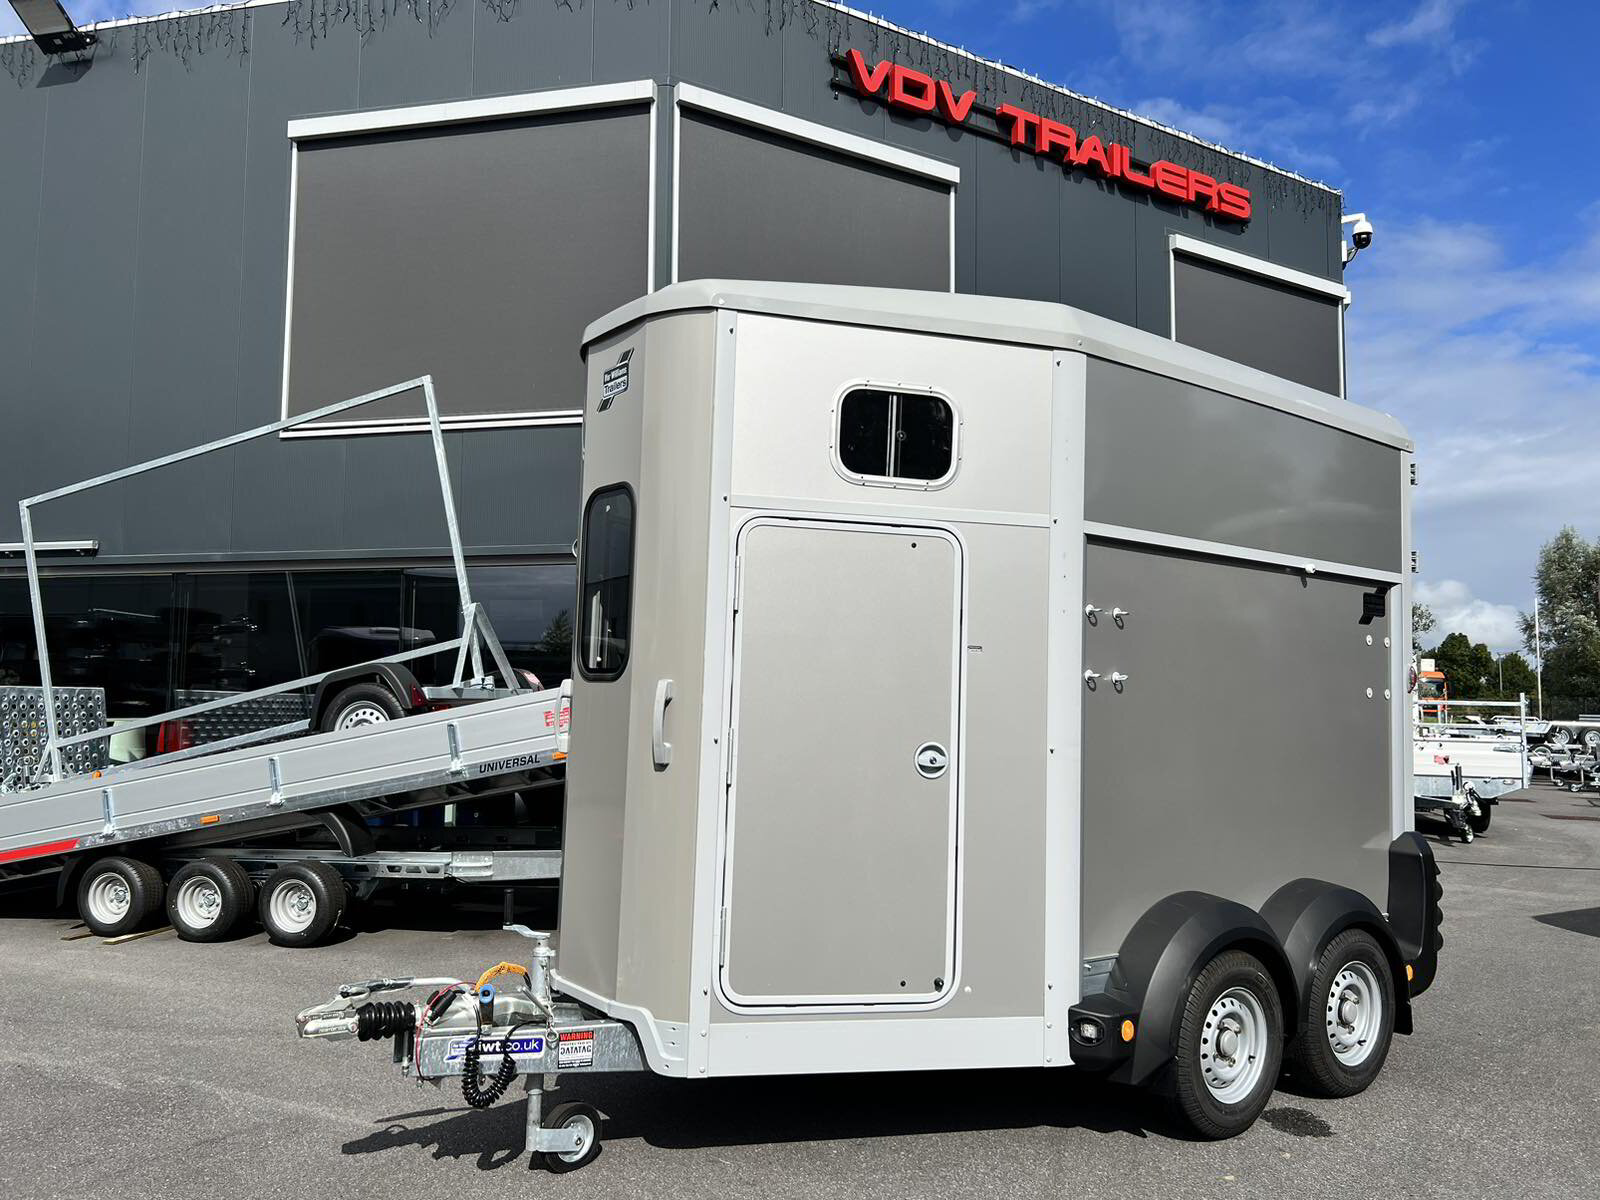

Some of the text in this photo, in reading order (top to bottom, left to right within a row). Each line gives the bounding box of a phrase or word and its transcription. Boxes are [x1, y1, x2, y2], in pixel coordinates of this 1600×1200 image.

[846, 48, 1252, 220] VDV TRAILERS
[479, 754, 540, 773] UNIVERSAL
[560, 1031, 592, 1040] WARNING
[560, 1045, 592, 1055] DATATAG
